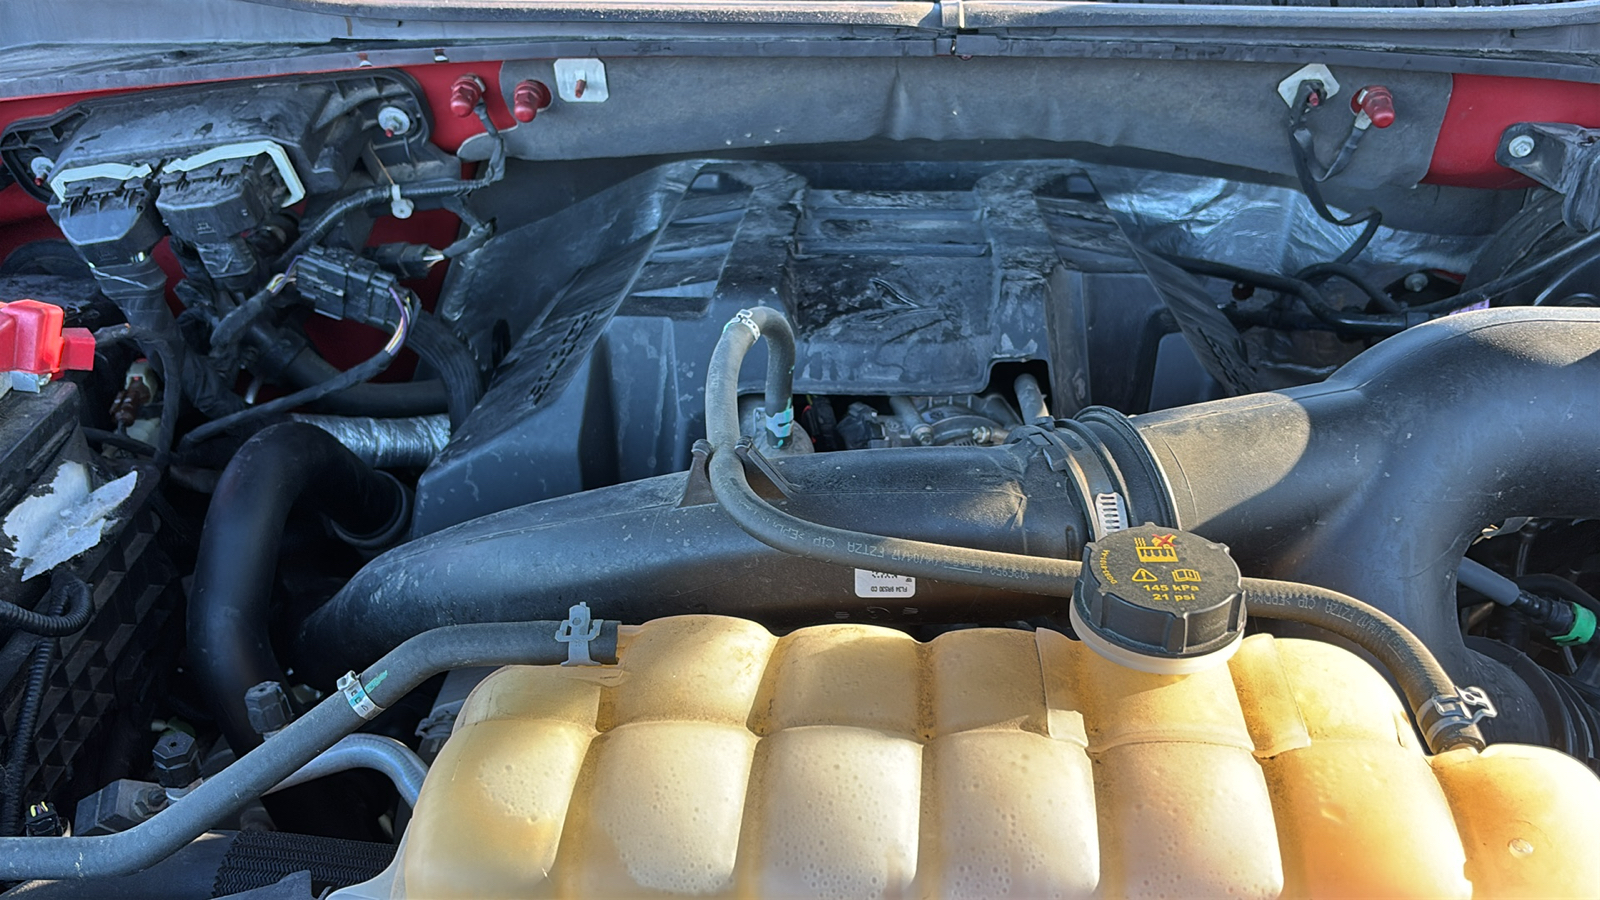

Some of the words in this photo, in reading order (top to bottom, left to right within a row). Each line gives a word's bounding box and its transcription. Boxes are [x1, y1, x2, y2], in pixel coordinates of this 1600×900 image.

[1143, 584, 1170, 592] 145
[1172, 584, 1200, 592] kPa
[1152, 593, 1170, 601] 21
[1174, 593, 1196, 602] psi
